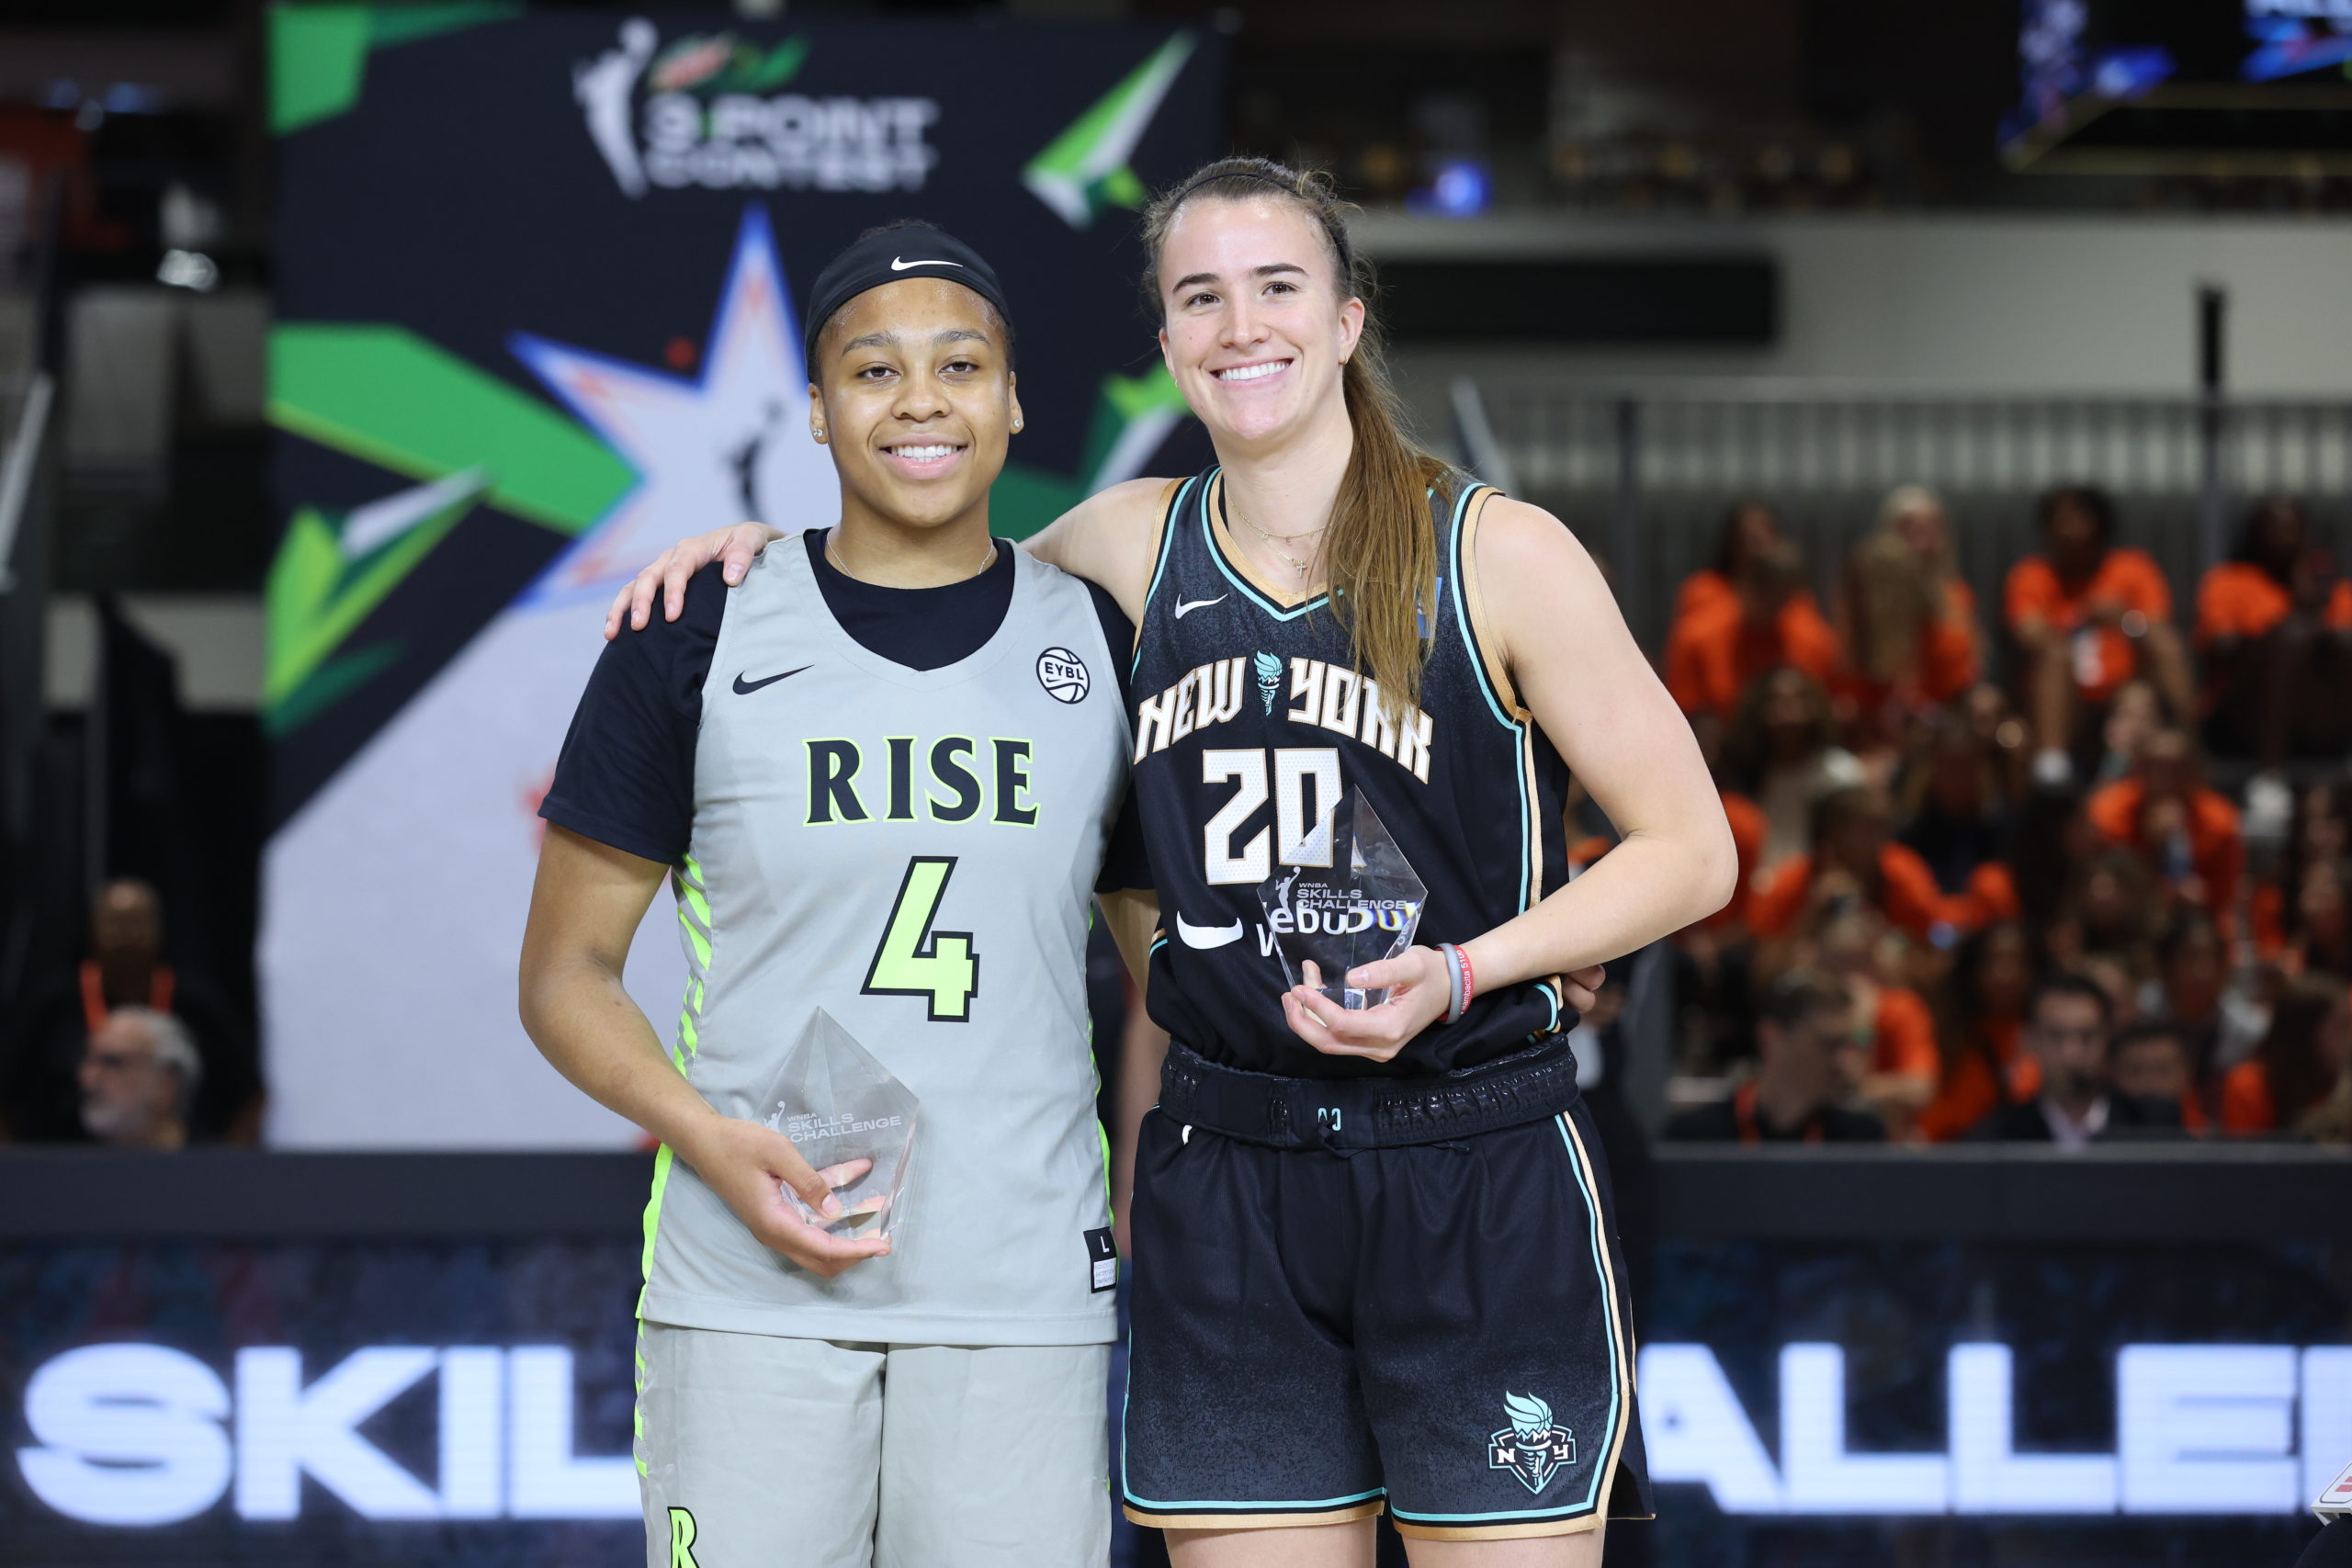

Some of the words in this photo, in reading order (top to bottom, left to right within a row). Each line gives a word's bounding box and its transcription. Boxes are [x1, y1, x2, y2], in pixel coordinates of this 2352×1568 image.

[1045, 661, 1084, 680] EYBL
[1134, 657, 1247, 765] NEW
[1288, 657, 1433, 784] YORK
[802, 734, 1041, 829] RISE
[1203, 748, 1343, 886] 20
[1296, 889, 1363, 899] SKILLS
[1296, 899, 1407, 910] CHALLENGE
[860, 855, 980, 1023] 4
[787, 1112, 818, 1122] WNBA
[788, 1113, 854, 1133] SKILLS
[790, 1115, 902, 1144] CHALLENGE
[1100, 1235, 1110, 1253] L
[1635, 1342, 2352, 1514] ALLE
[667, 1506, 699, 1568] R
